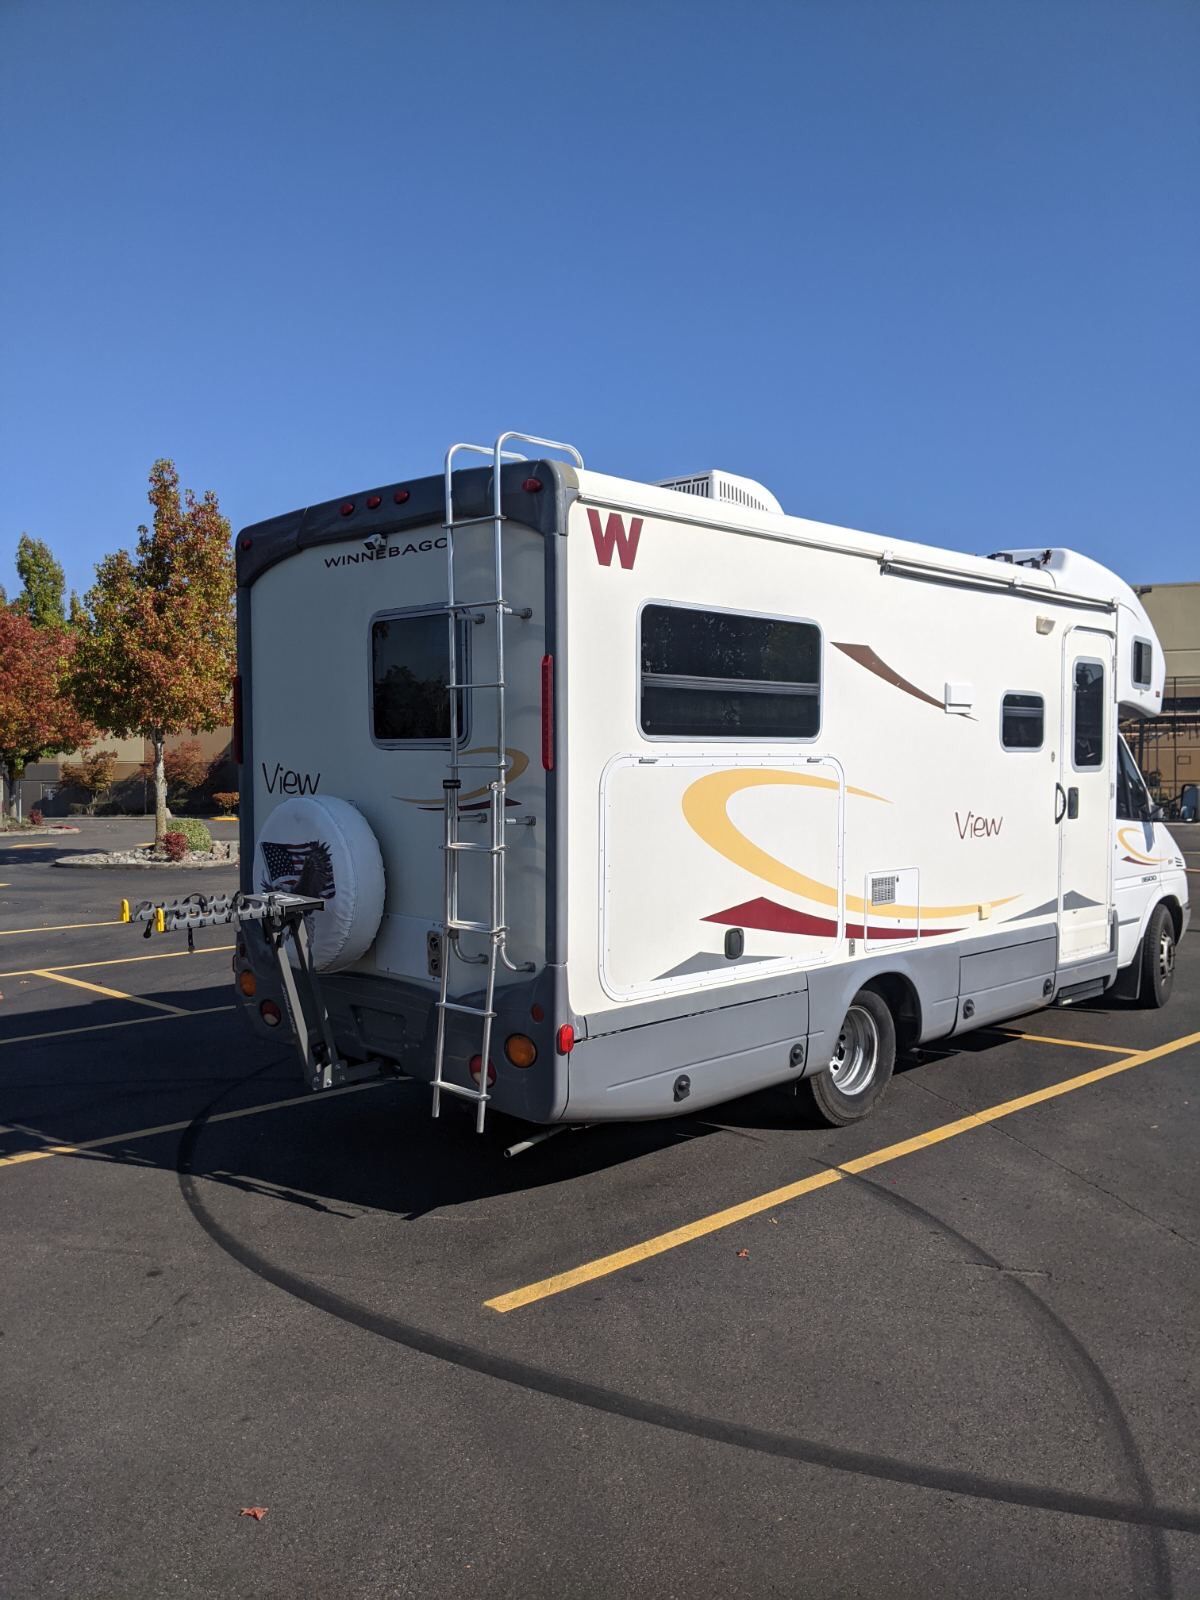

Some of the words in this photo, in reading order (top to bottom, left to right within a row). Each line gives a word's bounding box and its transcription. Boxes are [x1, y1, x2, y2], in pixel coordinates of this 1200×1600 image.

[324, 537, 448, 568] WINNEBAGO
[262, 762, 320, 796] View
[955, 810, 1004, 840] View
